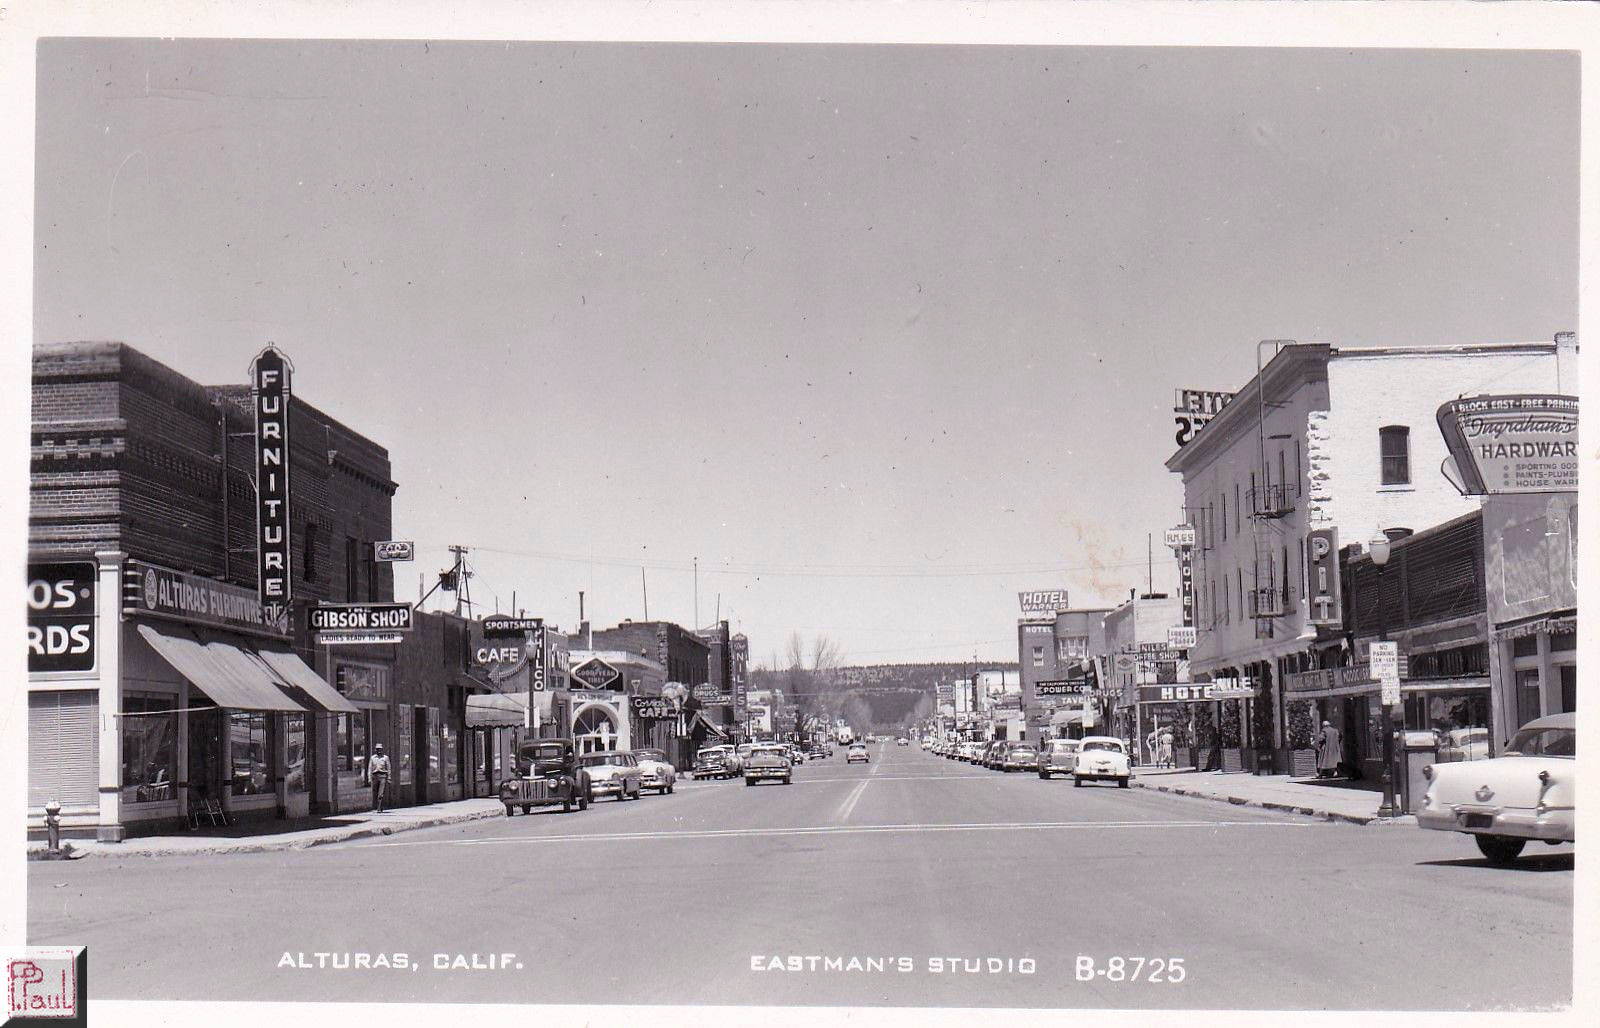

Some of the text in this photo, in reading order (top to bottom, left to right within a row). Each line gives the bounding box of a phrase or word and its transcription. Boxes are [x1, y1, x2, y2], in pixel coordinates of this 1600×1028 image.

[1459, 401, 1488, 412] BLOCK
[1466, 414, 1577, 439] Ingraham's
[261, 370, 284, 596] FURNITURE
[1183, 551, 1192, 621] HOTEL
[1312, 537, 1334, 623] PIT
[159, 578, 208, 614] ALTURAS
[209, 590, 263, 624] FURNITURE
[1023, 591, 1068, 604] HOTEL
[1022, 603, 1067, 611] WARNER
[311, 608, 409, 628] GIBSON SHOP
[485, 621, 538, 630] SPORTSMEN
[321, 634, 344, 642] LADIES
[477, 647, 519, 663] CAFE
[1159, 651, 1180, 660] SHOP
[736, 652, 746, 706] NILES
[1043, 685, 1072, 694] POWER
[1089, 688, 1124, 698] DRUGS
[1161, 686, 1217, 700] HOTE
